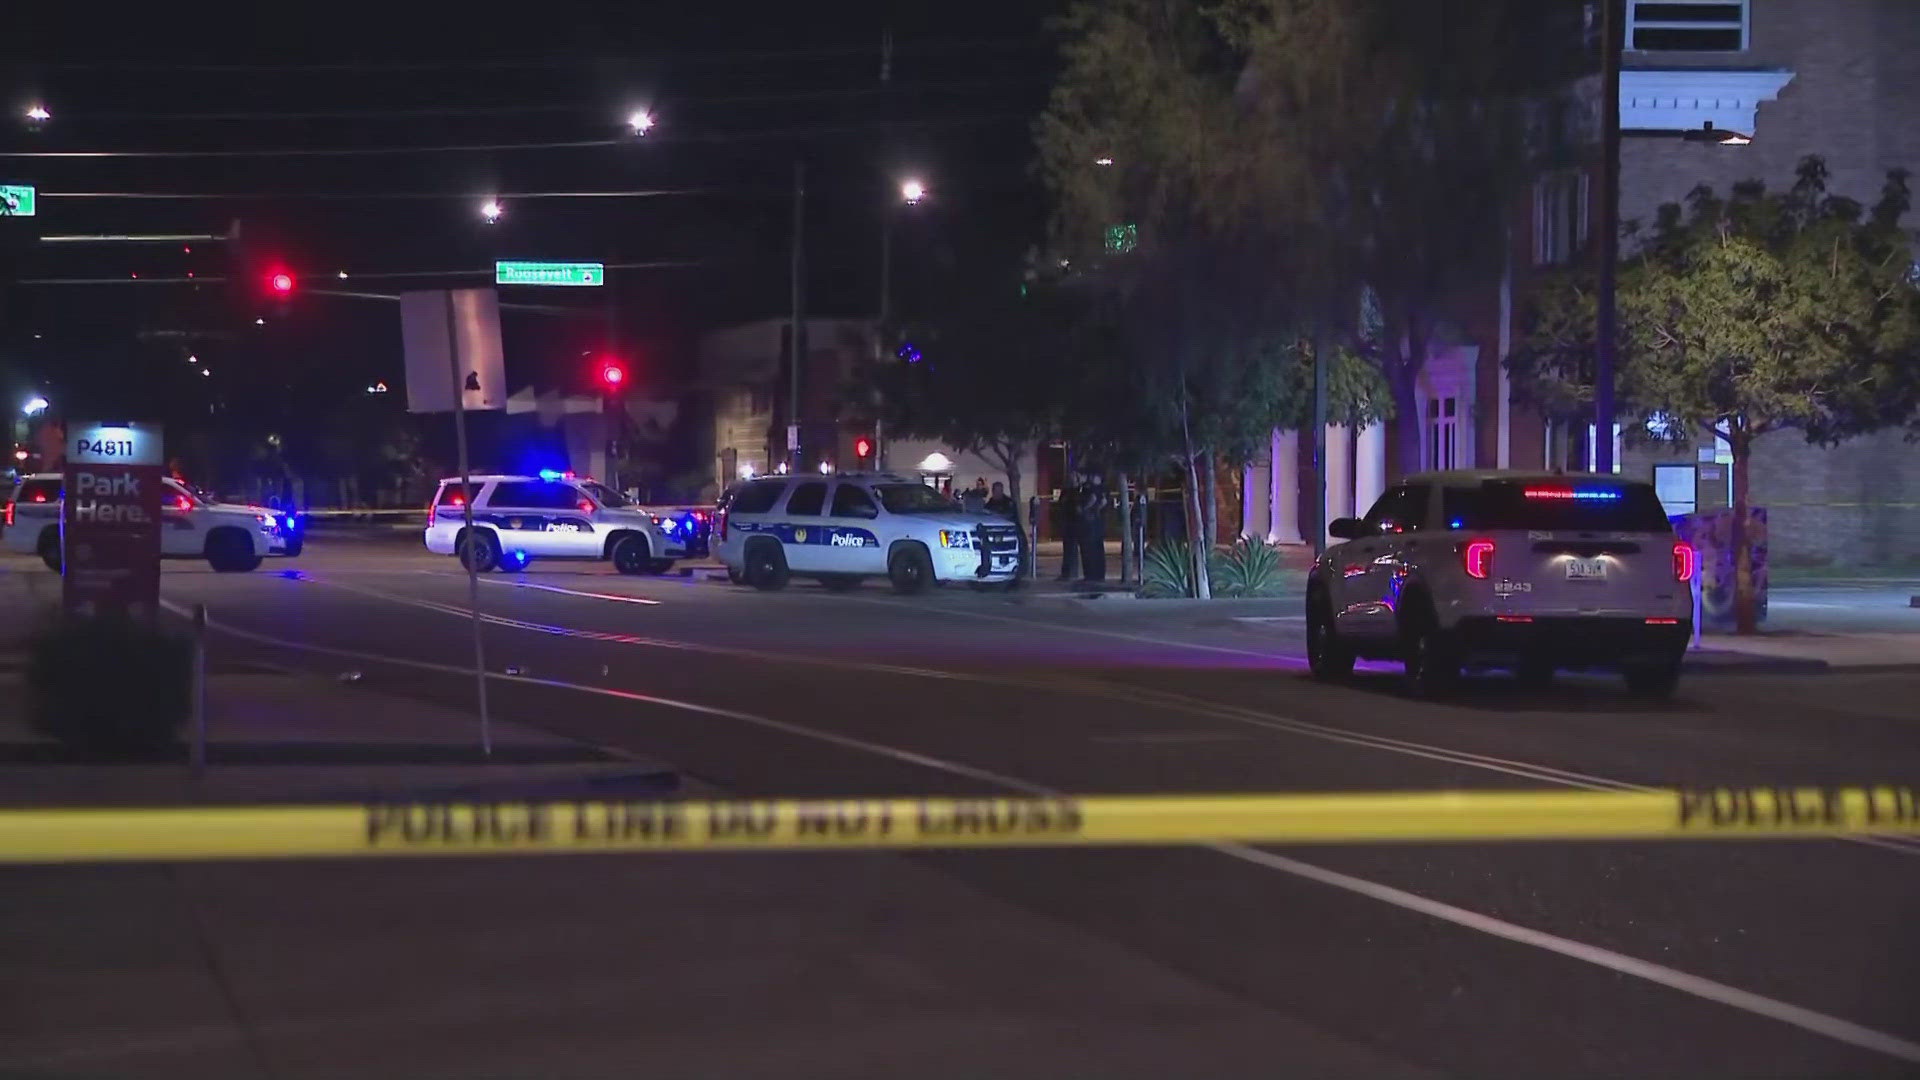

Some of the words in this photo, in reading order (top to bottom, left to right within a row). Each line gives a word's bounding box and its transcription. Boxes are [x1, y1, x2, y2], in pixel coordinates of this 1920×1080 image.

[77, 439, 132, 456] P4811
[76, 472, 140, 496] Park
[76, 499, 152, 523] Here.
[831, 533, 864, 547] Police
[1679, 787, 1843, 827] POLICE
[365, 803, 550, 844] POLICE
[573, 802, 680, 842] LINE
[708, 801, 779, 840] DO
[796, 801, 893, 837] NOT
[917, 799, 1084, 835] CROSS
